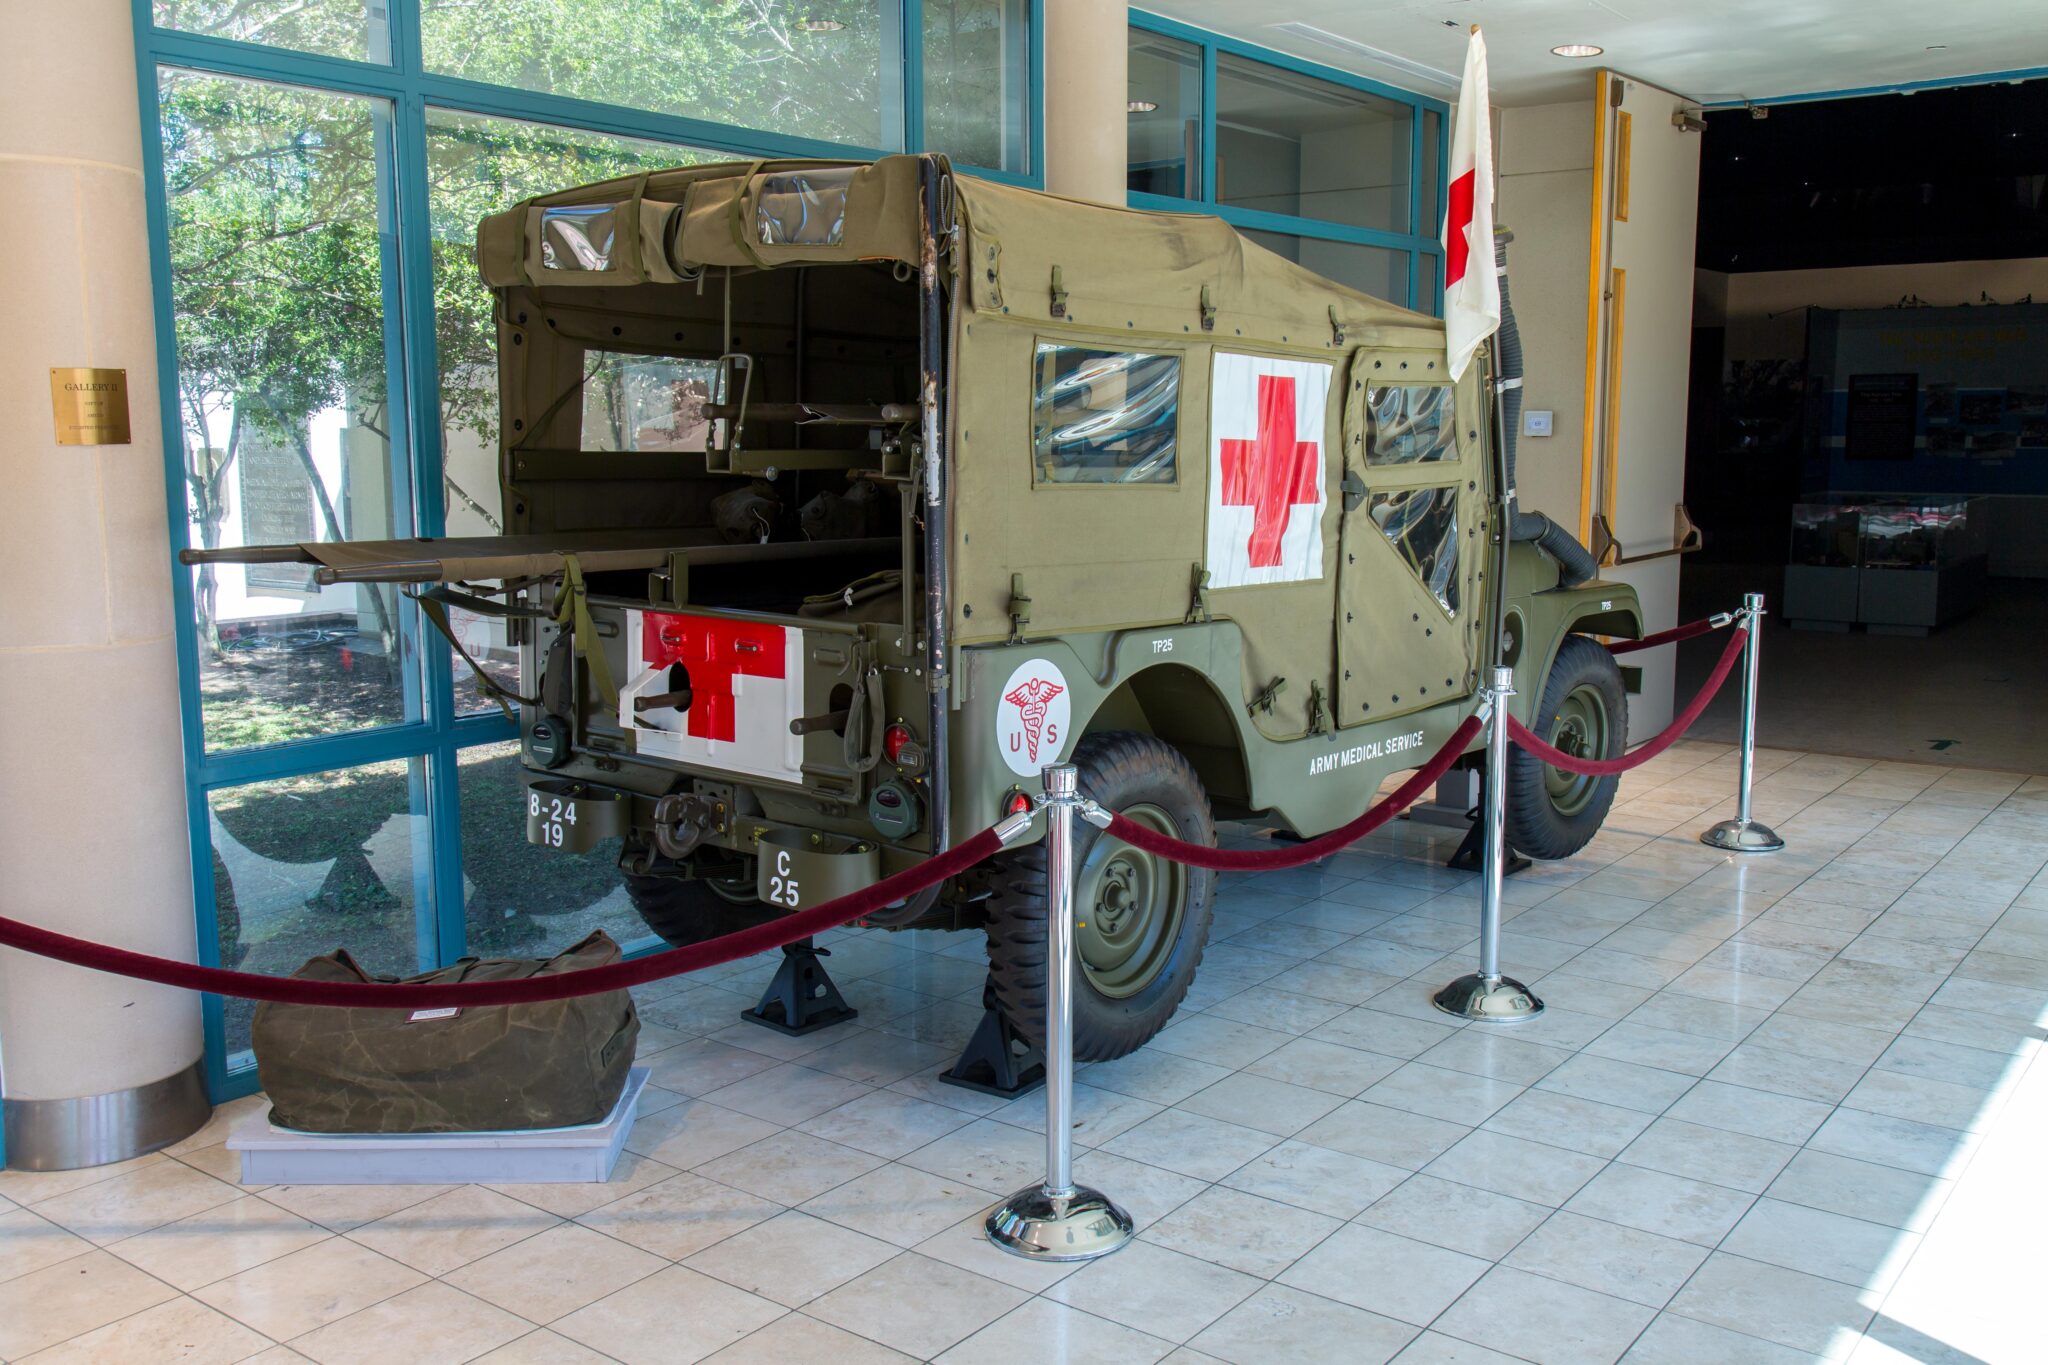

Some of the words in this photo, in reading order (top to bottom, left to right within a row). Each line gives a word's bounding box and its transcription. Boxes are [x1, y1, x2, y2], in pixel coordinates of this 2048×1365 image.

[64, 383, 111, 392] GALLERY
[1152, 638, 1173, 654] TP25
[1010, 731, 1021, 752] U
[1047, 724, 1057, 744] S
[1309, 752, 1339, 776] ARMY
[1340, 745, 1383, 768] MEDICAL
[1385, 730, 1424, 754] SERVICE
[530, 793, 577, 826] 8-24
[541, 821, 563, 847] 19
[777, 850, 790, 877] C
[770, 876, 799, 907] 25
